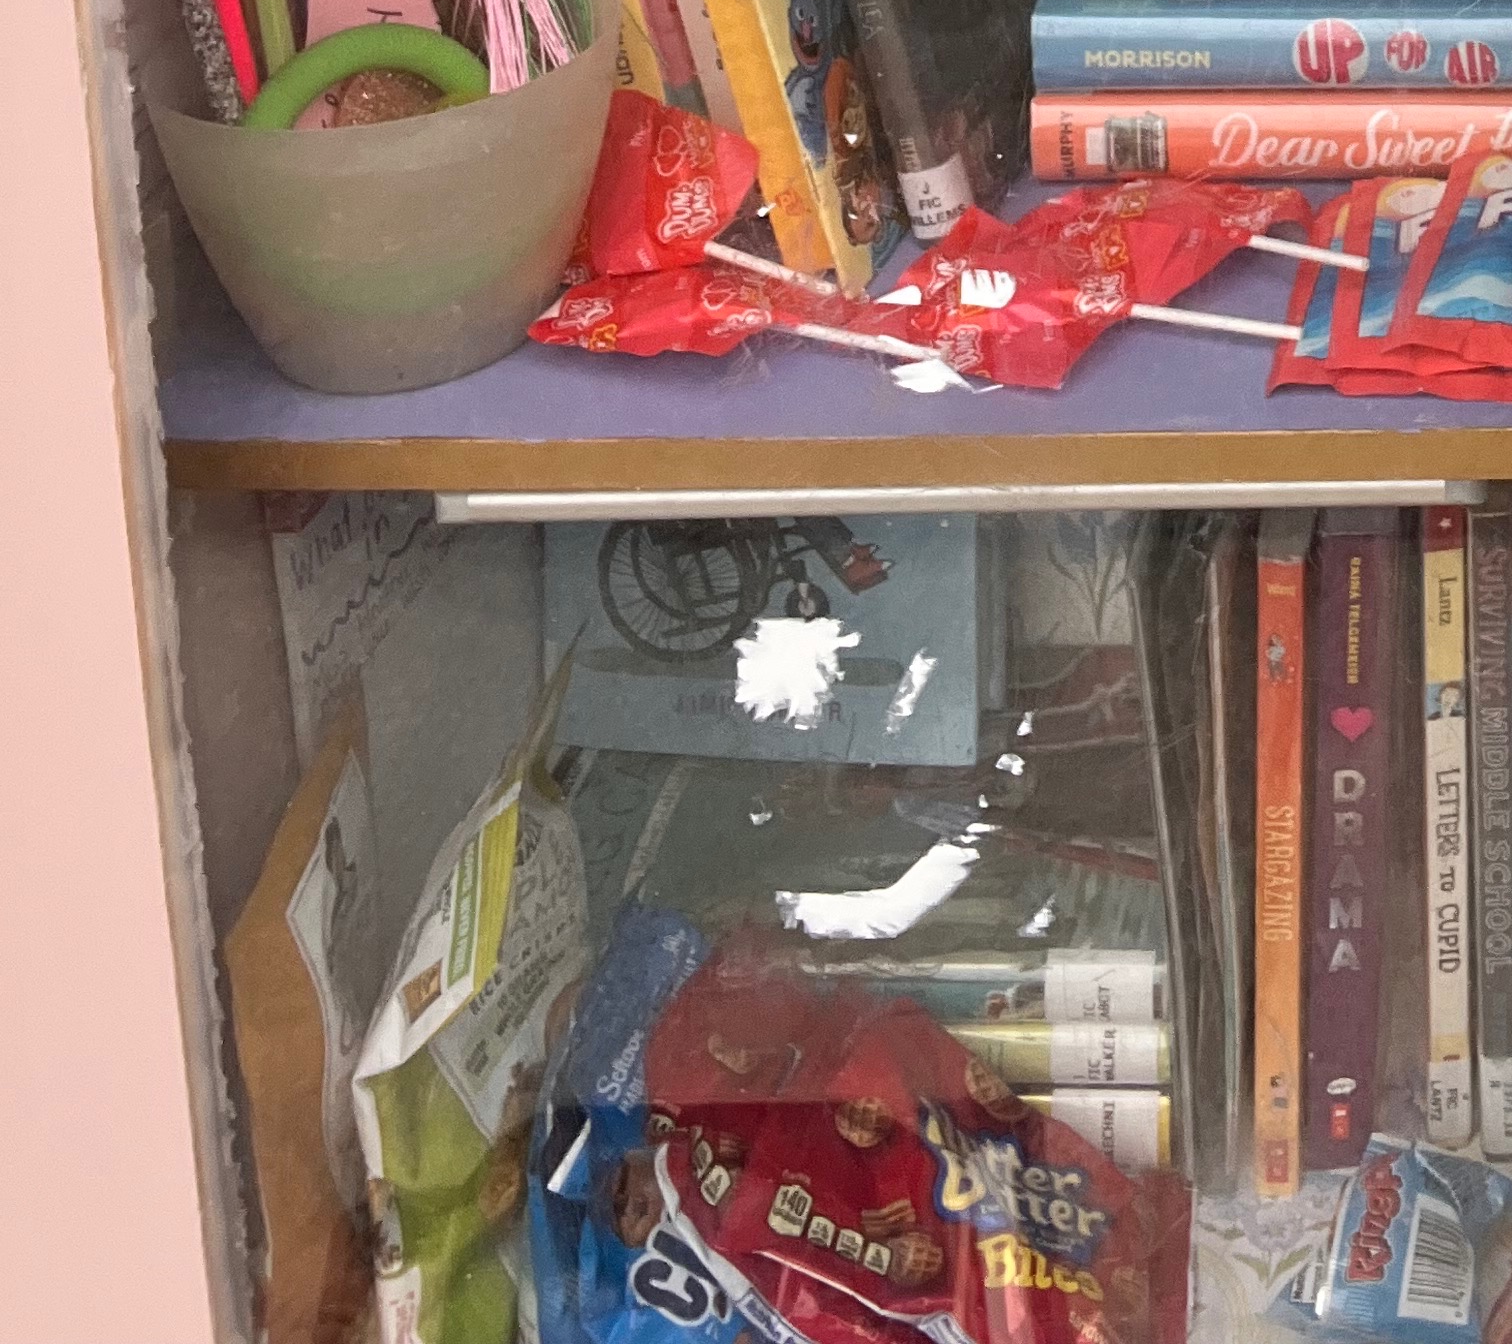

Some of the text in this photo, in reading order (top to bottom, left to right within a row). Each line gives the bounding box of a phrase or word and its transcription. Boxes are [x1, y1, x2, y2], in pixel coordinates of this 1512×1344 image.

[1084, 49, 1211, 70] MORRISON
[1296, 17, 1498, 86] UP FOR AIR
[1060, 111, 1076, 179] MURPHY
[1208, 111, 1340, 168] Dear
[1344, 108, 1482, 170] Sweet
[918, 197, 942, 210] FIC
[922, 181, 930, 195] J
[1348, 556, 1362, 599] RAINA
[1438, 576, 1458, 627] Lantz
[1475, 545, 1508, 702] SURVIVING
[1480, 706, 1511, 830] MIDDLE
[1261, 805, 1295, 943] STARGAZING
[1328, 769, 1367, 974] DRAMA
[1436, 767, 1461, 975] LETTERS TO CUPID
[1083, 1001, 1096, 1019] IC
[780, 1188, 809, 1218] 140
[1345, 1185, 1401, 1283] Ring
